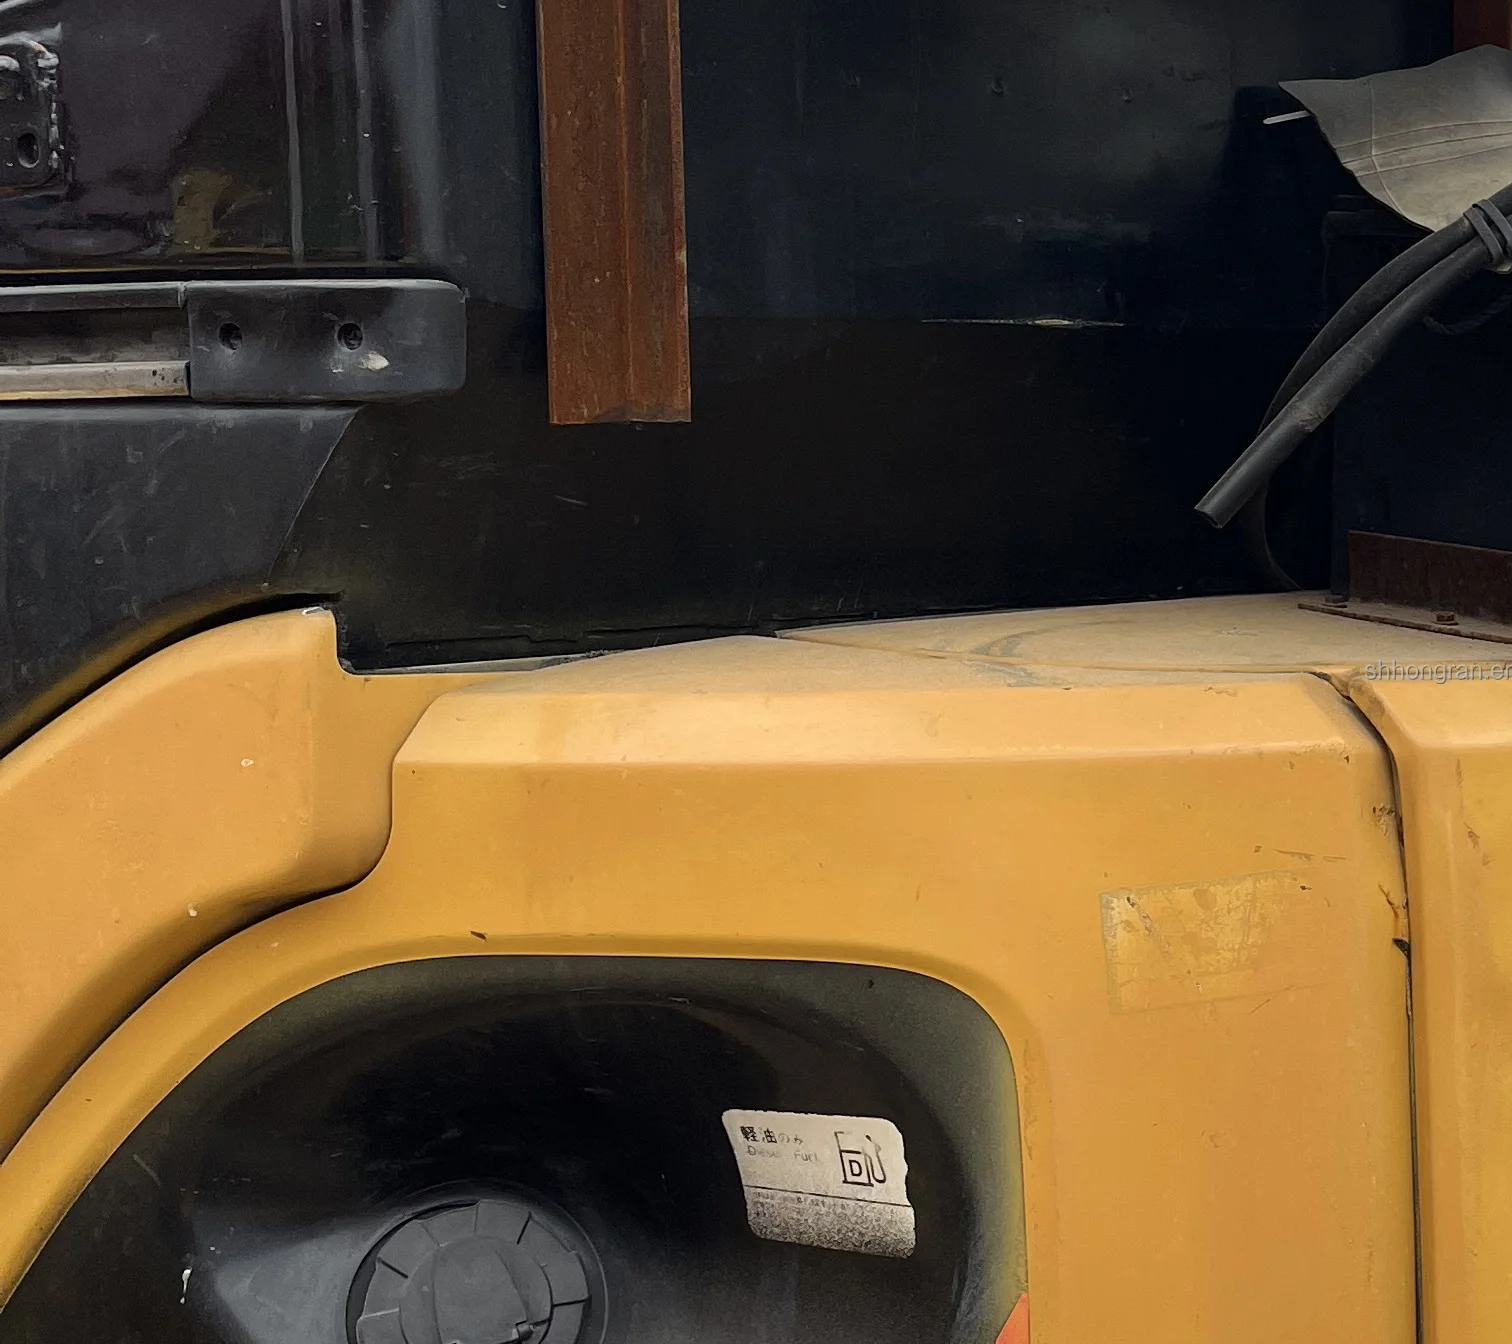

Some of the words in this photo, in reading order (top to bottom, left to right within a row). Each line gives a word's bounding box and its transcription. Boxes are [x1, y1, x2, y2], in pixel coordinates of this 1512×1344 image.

[739, 1125, 804, 1145] 軽油のみ
[849, 1160, 863, 1177] D
